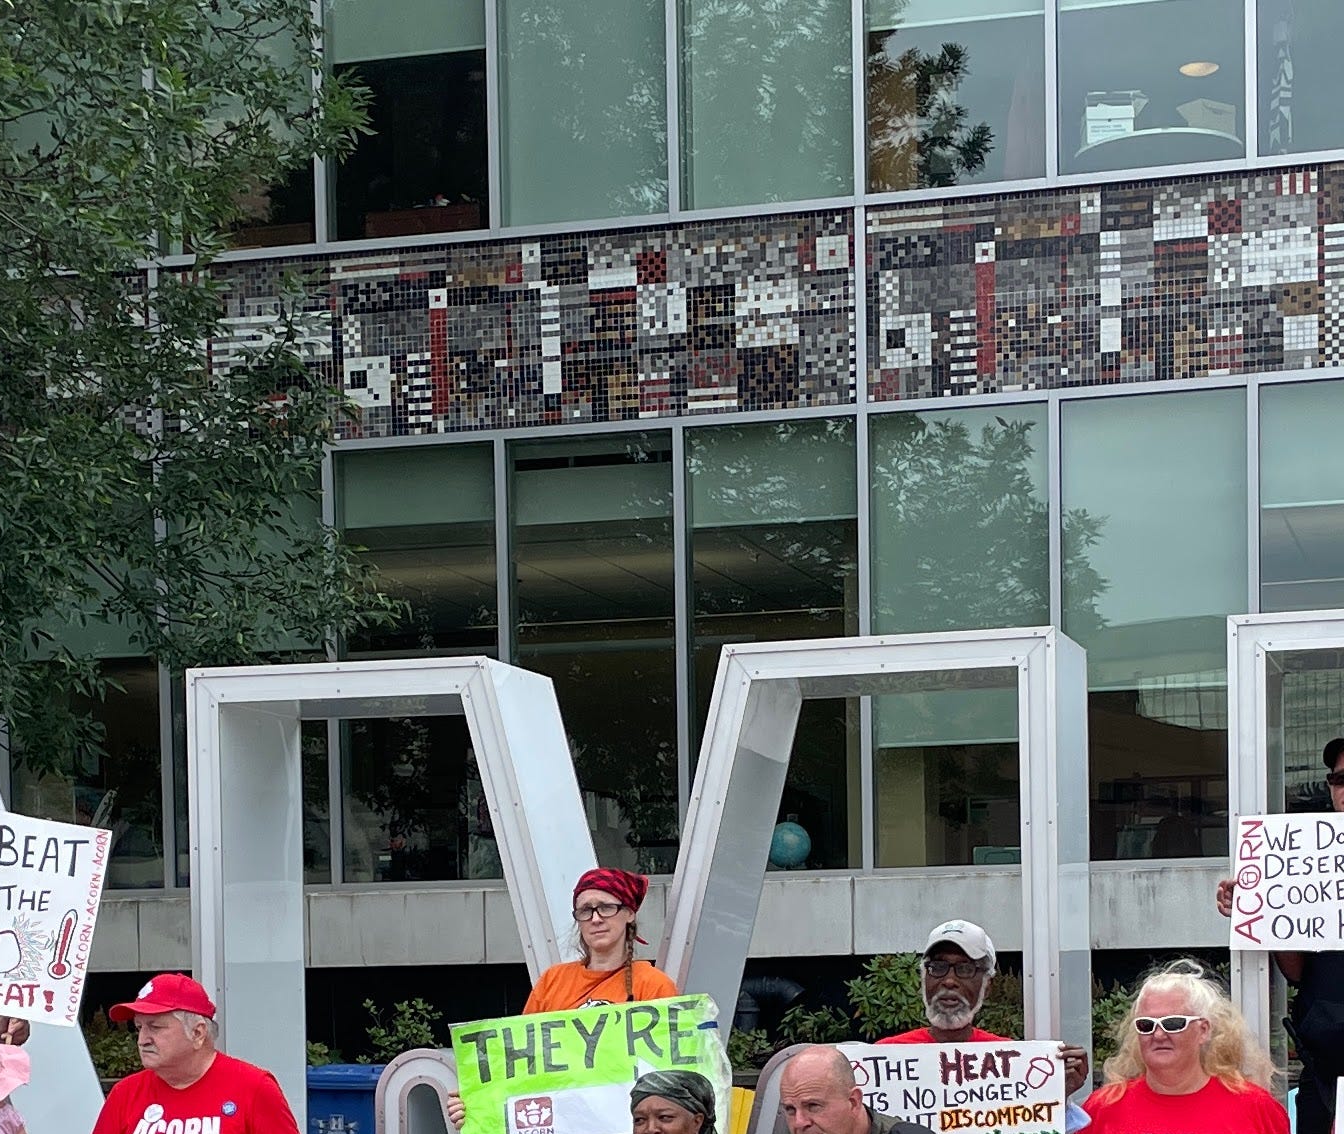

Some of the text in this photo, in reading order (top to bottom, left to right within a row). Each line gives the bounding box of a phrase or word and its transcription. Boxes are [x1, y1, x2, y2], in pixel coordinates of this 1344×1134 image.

[1264, 823, 1303, 850] WE
[1235, 820, 1264, 944] ACORN
[0, 884, 51, 912] THE
[1271, 914, 1325, 940] OUR
[460, 1000, 704, 1083] THEY'RE
[862, 1048, 1021, 1087] THE HEAT
[903, 1086, 936, 1110] NO
[943, 1081, 1028, 1107] LONGER
[940, 1101, 1060, 1131] DISCOMFORT
